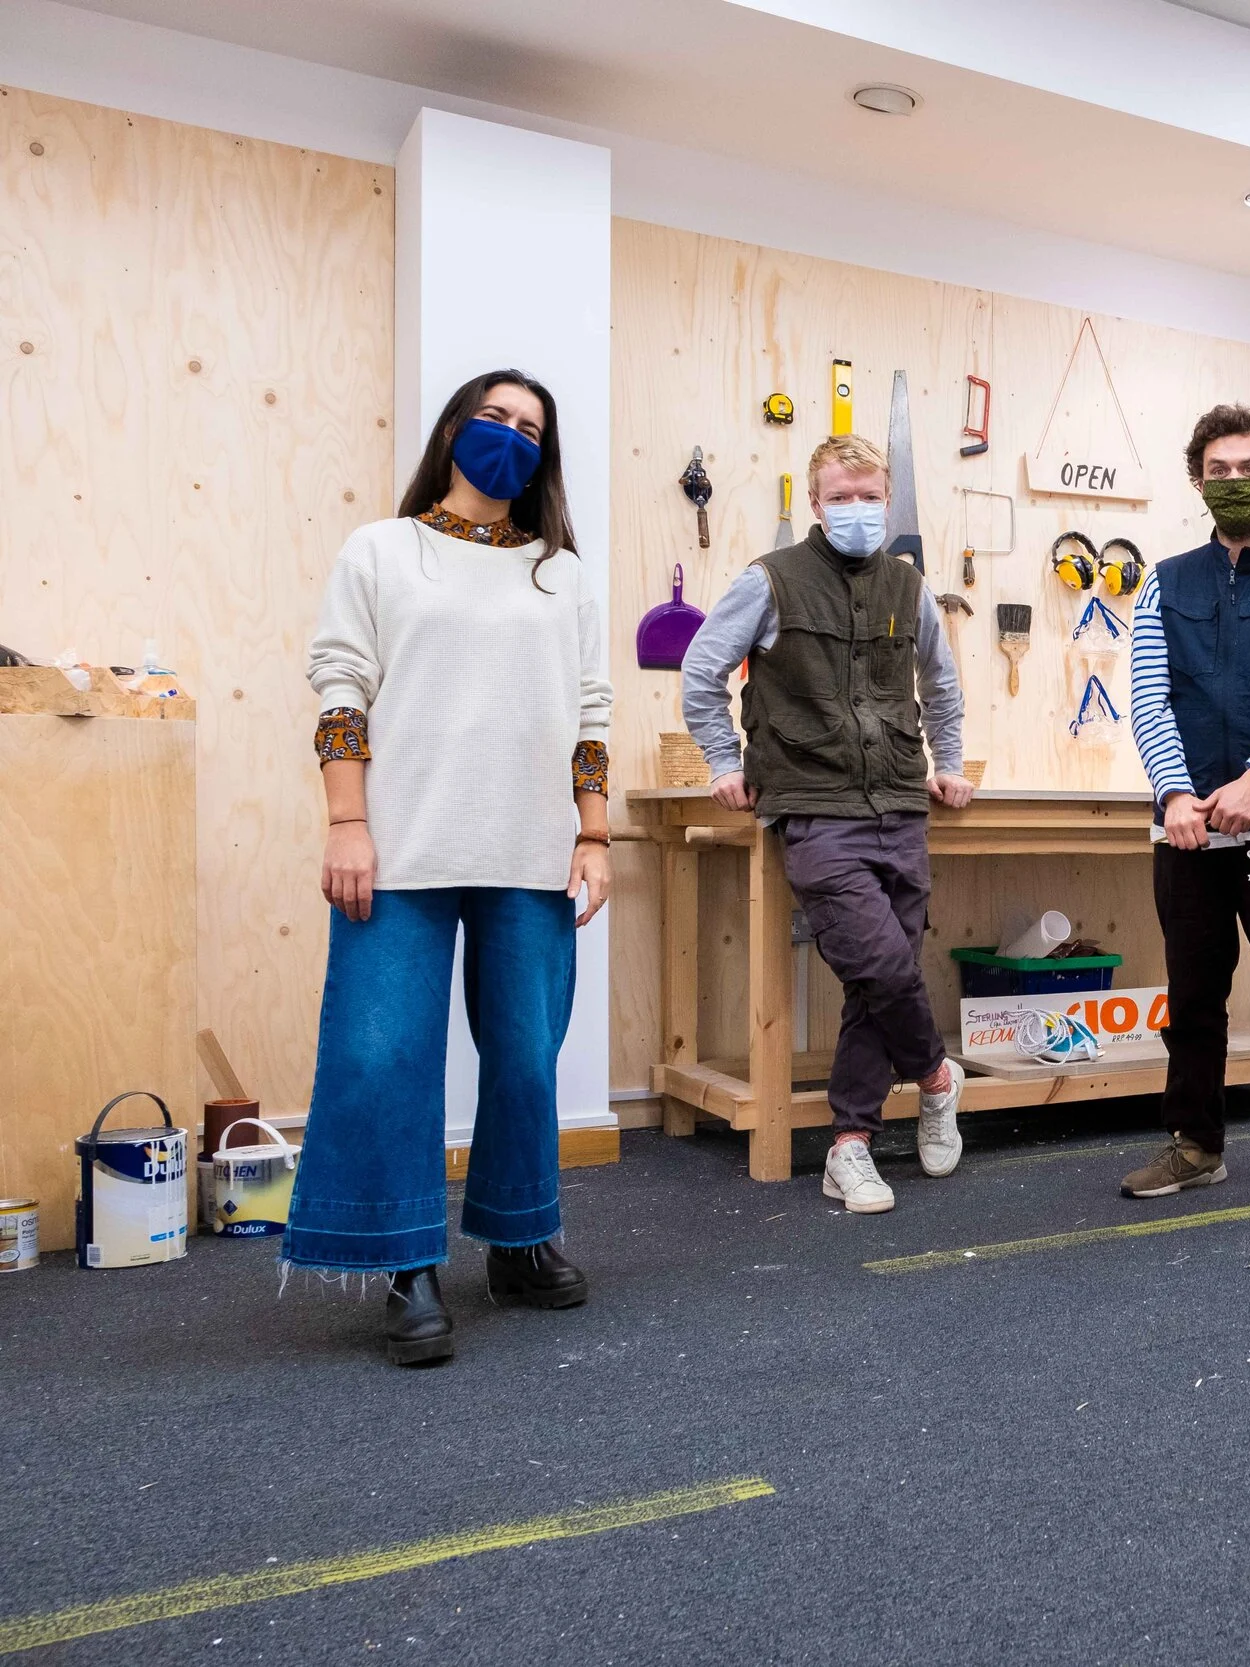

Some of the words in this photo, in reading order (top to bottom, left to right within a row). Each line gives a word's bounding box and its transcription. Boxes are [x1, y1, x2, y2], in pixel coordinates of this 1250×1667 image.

[1060, 462, 1117, 490] OPEN
[968, 1027, 1015, 1047] REDU
[233, 1224, 266, 1234] Dulux
